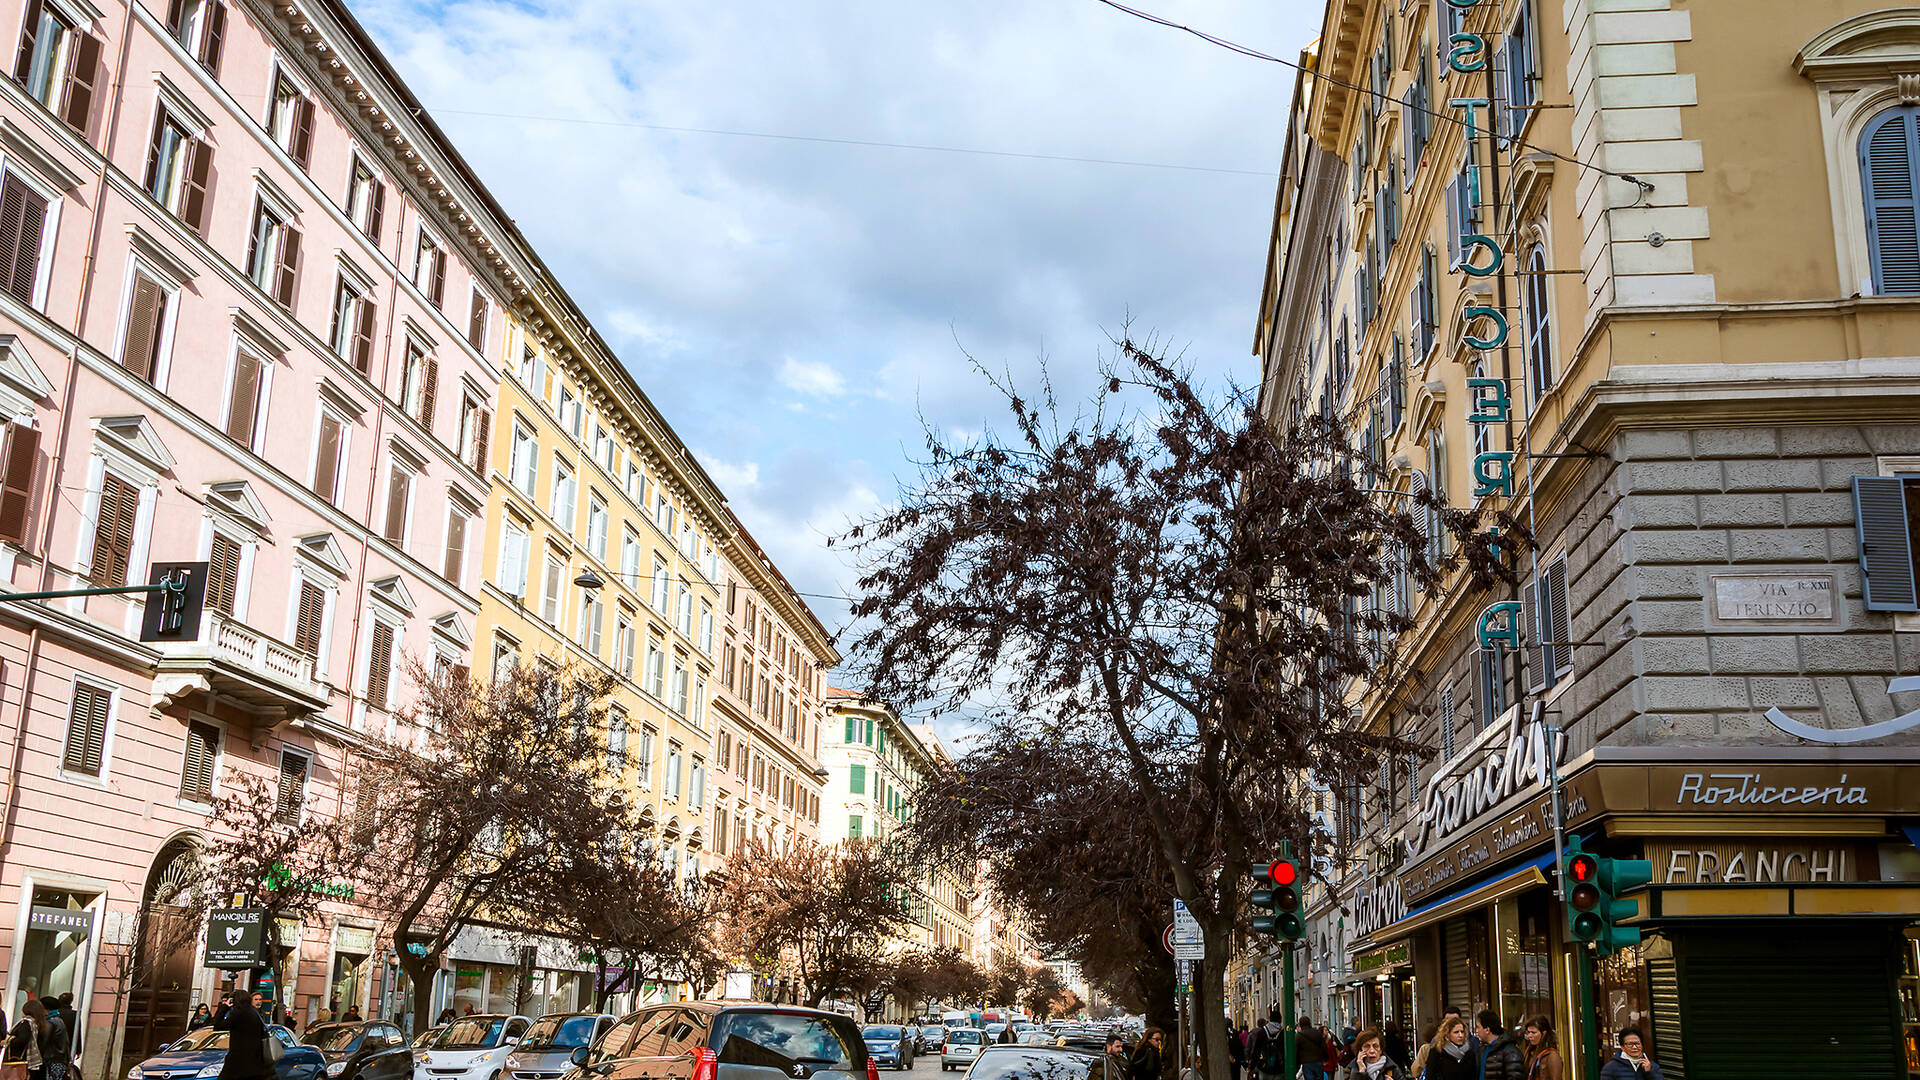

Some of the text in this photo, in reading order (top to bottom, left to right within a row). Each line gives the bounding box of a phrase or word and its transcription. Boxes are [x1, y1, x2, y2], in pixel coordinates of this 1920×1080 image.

[1759, 583, 1788, 596] VIA
[1677, 773, 1868, 804] Rosticceria
[1666, 851, 1845, 884] FRANCHI
[31, 912, 88, 928] STEFANEL
